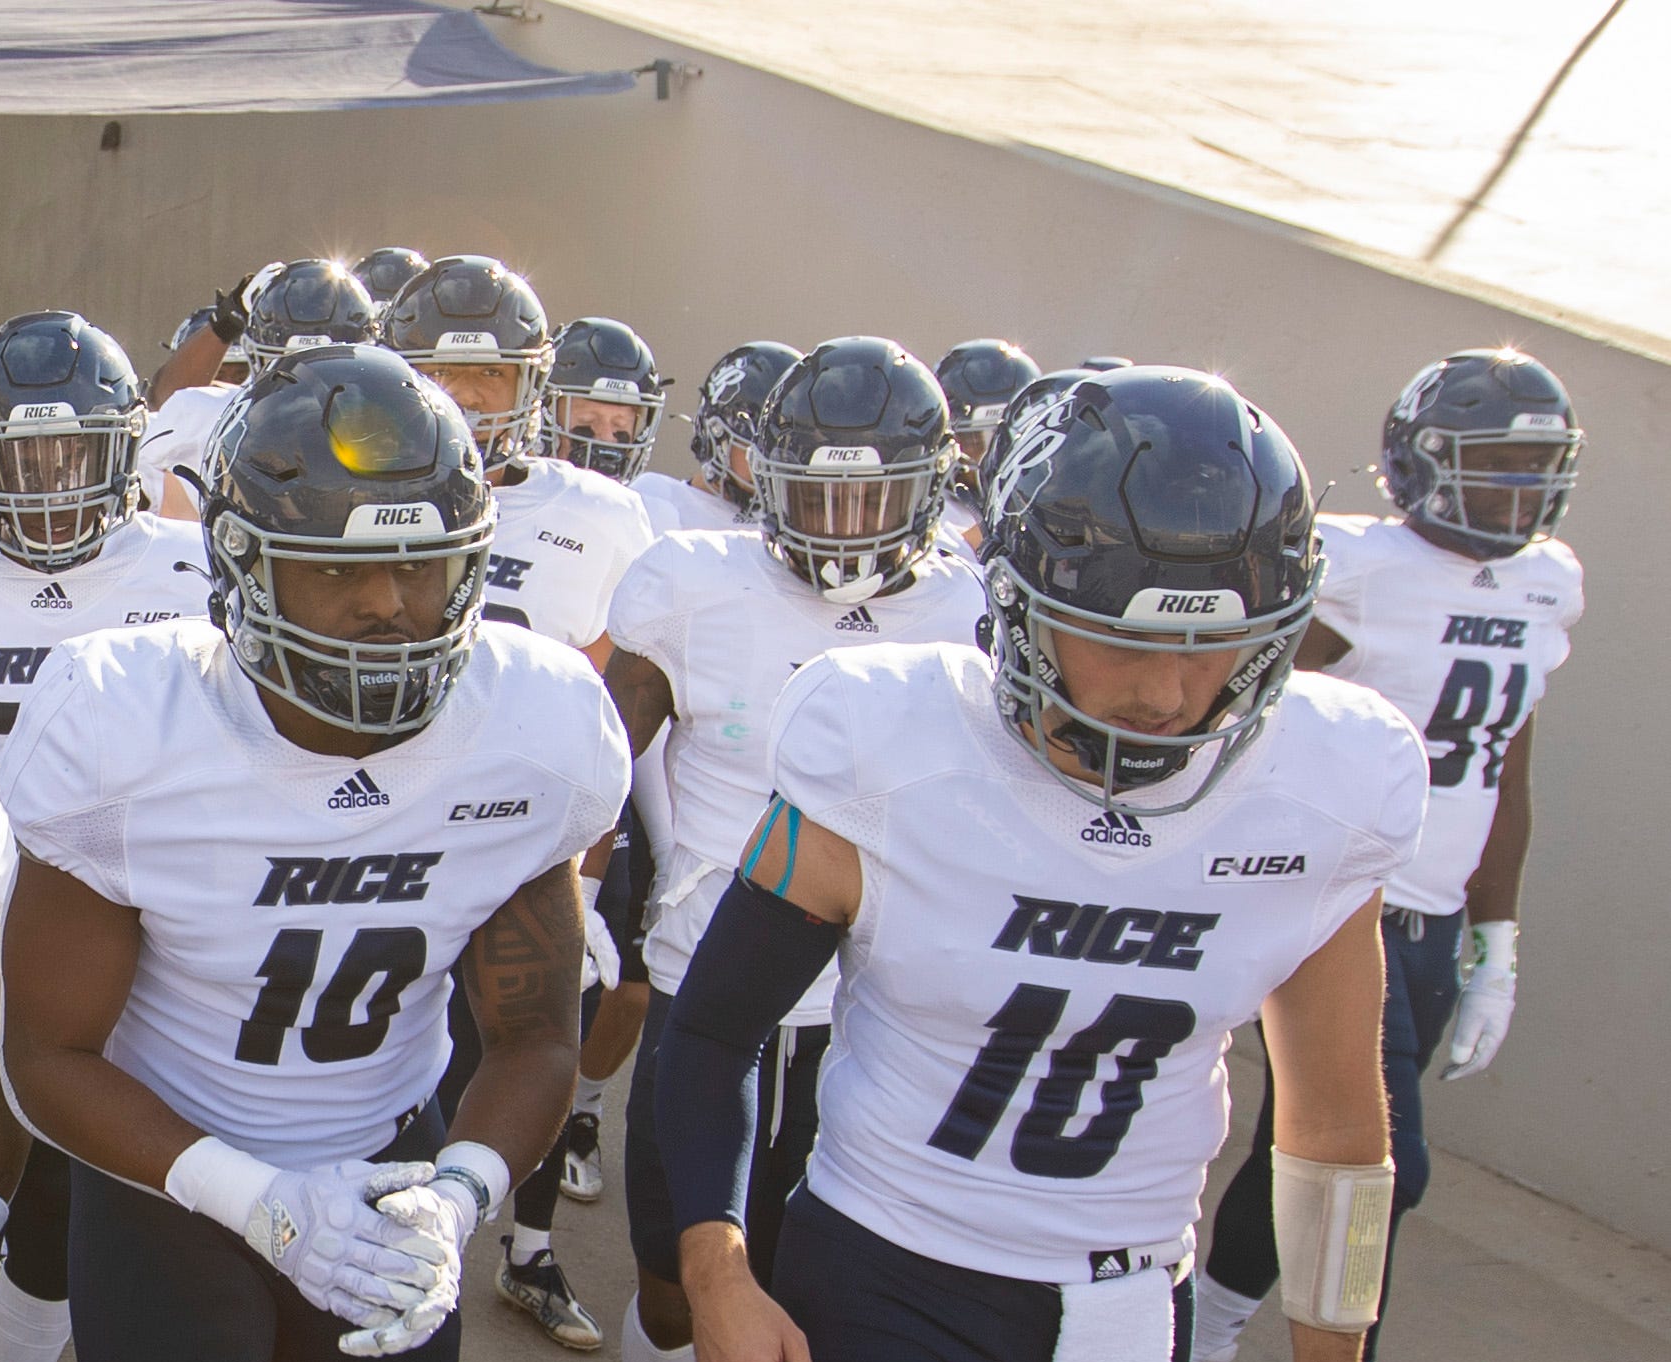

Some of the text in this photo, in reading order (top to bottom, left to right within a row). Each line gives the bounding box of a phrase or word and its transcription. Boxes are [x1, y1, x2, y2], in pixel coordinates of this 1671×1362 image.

[298, 336, 322, 346] RICE
[450, 333, 483, 344] RICE
[24, 406, 58, 419] RICE
[826, 448, 864, 463] RICE
[374, 507, 423, 526] RICE
[244, 573, 271, 612] Ridd
[443, 565, 477, 621] Ridde
[30, 598, 73, 610] adidas
[1156, 594, 1220, 614] RICE
[834, 621, 881, 634] adidas
[1441, 615, 1528, 649] RICE
[1229, 637, 1287, 695] Riddell
[359, 672, 407, 687] Riddel
[1423, 659, 1528, 789] 91
[1120, 757, 1165, 770] Riddell
[328, 791, 391, 810] adidas
[1080, 824, 1153, 848] adidas
[253, 851, 445, 906] RICE
[990, 893, 1221, 972] RICE
[234, 926, 427, 1066] 10
[926, 982, 1196, 1179] 10
[271, 1200, 283, 1259] adidas
[1139, 1254, 1152, 1271] M
